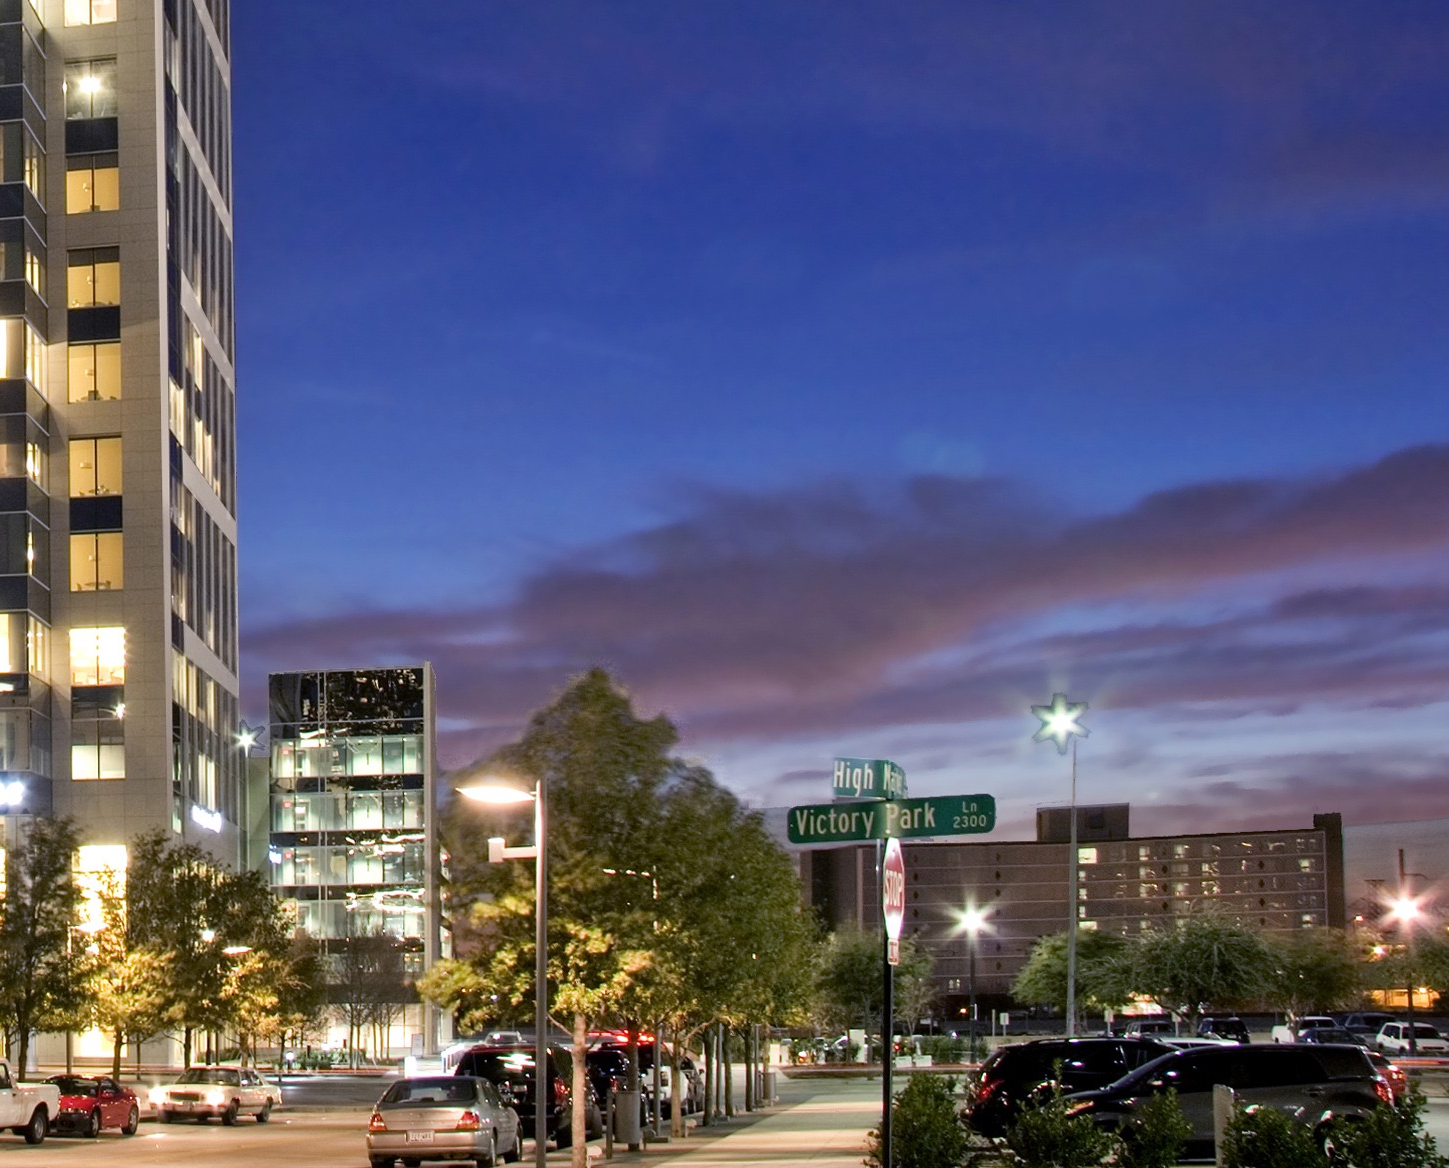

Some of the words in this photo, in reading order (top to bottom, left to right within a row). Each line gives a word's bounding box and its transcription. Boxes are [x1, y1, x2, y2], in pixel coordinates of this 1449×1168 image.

[833, 760, 874, 797] High
[795, 809, 874, 838] Victory
[886, 802, 936, 831] Park
[953, 814, 987, 829] 2300
[962, 801, 977, 813] Ln
[884, 869, 903, 907] STOP
